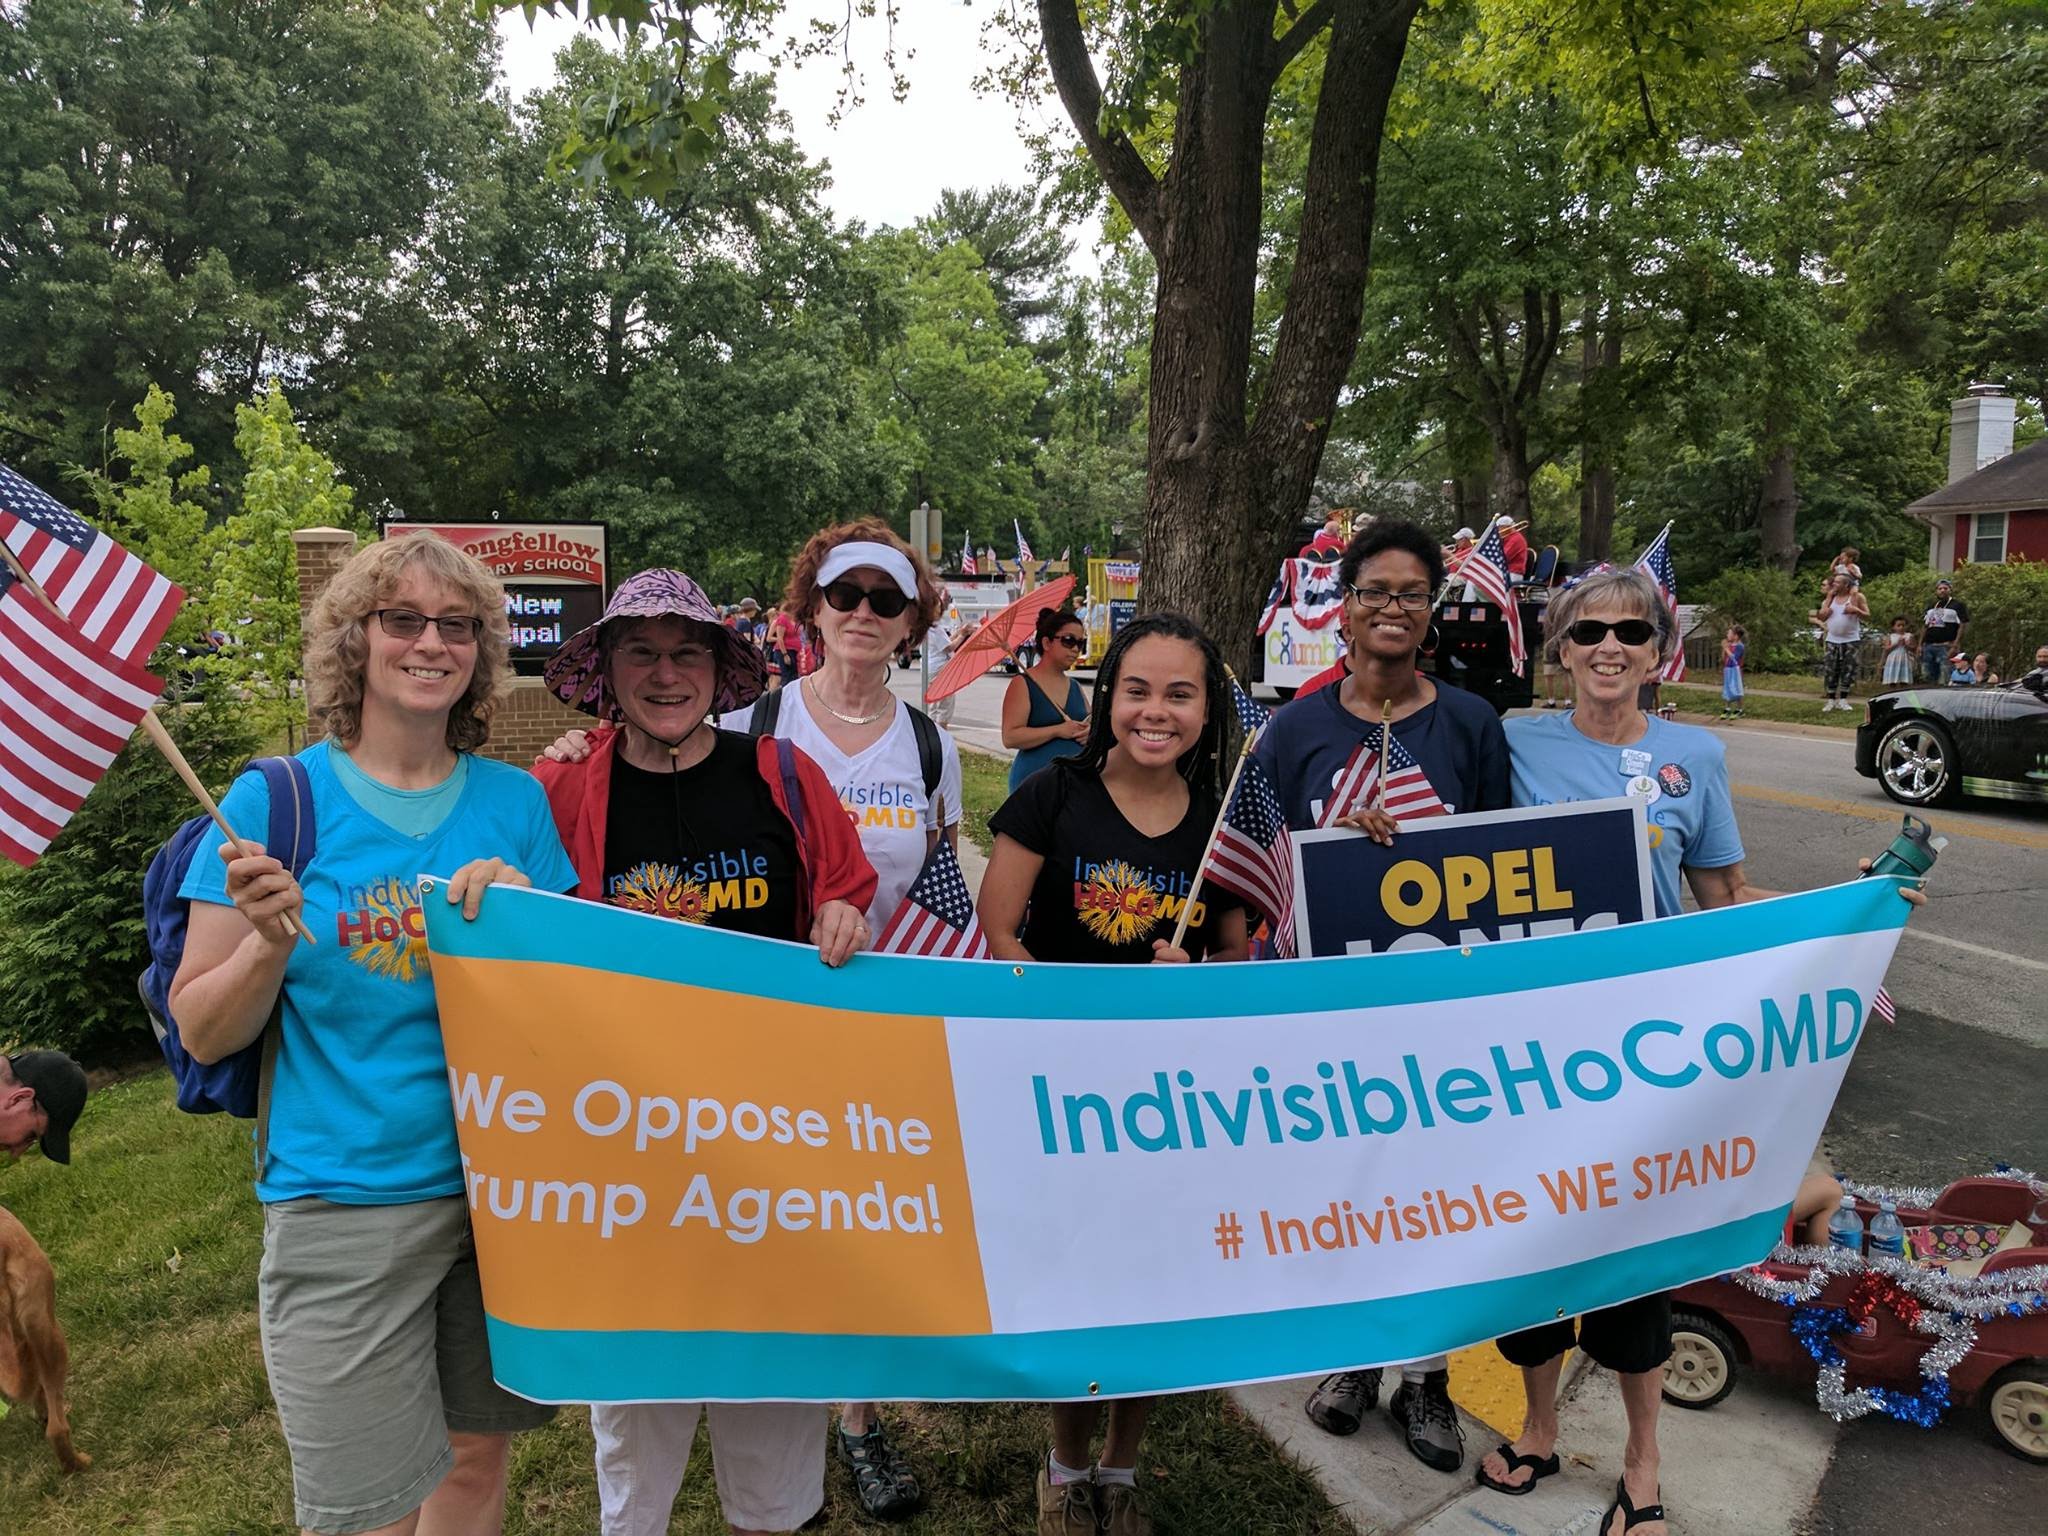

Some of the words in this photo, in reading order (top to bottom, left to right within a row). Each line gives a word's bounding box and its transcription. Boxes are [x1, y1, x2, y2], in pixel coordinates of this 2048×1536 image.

[524, 558, 595, 575] SCHOOL
[504, 593, 562, 615] New
[604, 848, 768, 896] ndivisible
[1380, 847, 1574, 927] OPEL
[337, 906, 426, 947] HoC
[1031, 988, 1863, 1155] IndivisibleHoCoMD
[447, 1066, 547, 1133] We
[572, 1079, 830, 1154] Oppose
[843, 1102, 933, 1156] the
[670, 1173, 944, 1244] Agenda!
[1214, 1212, 1243, 1259] #
[1260, 1184, 1527, 1256] Indivisible
[1538, 1162, 1618, 1216] WE
[1632, 1136, 1757, 1201] STAND
